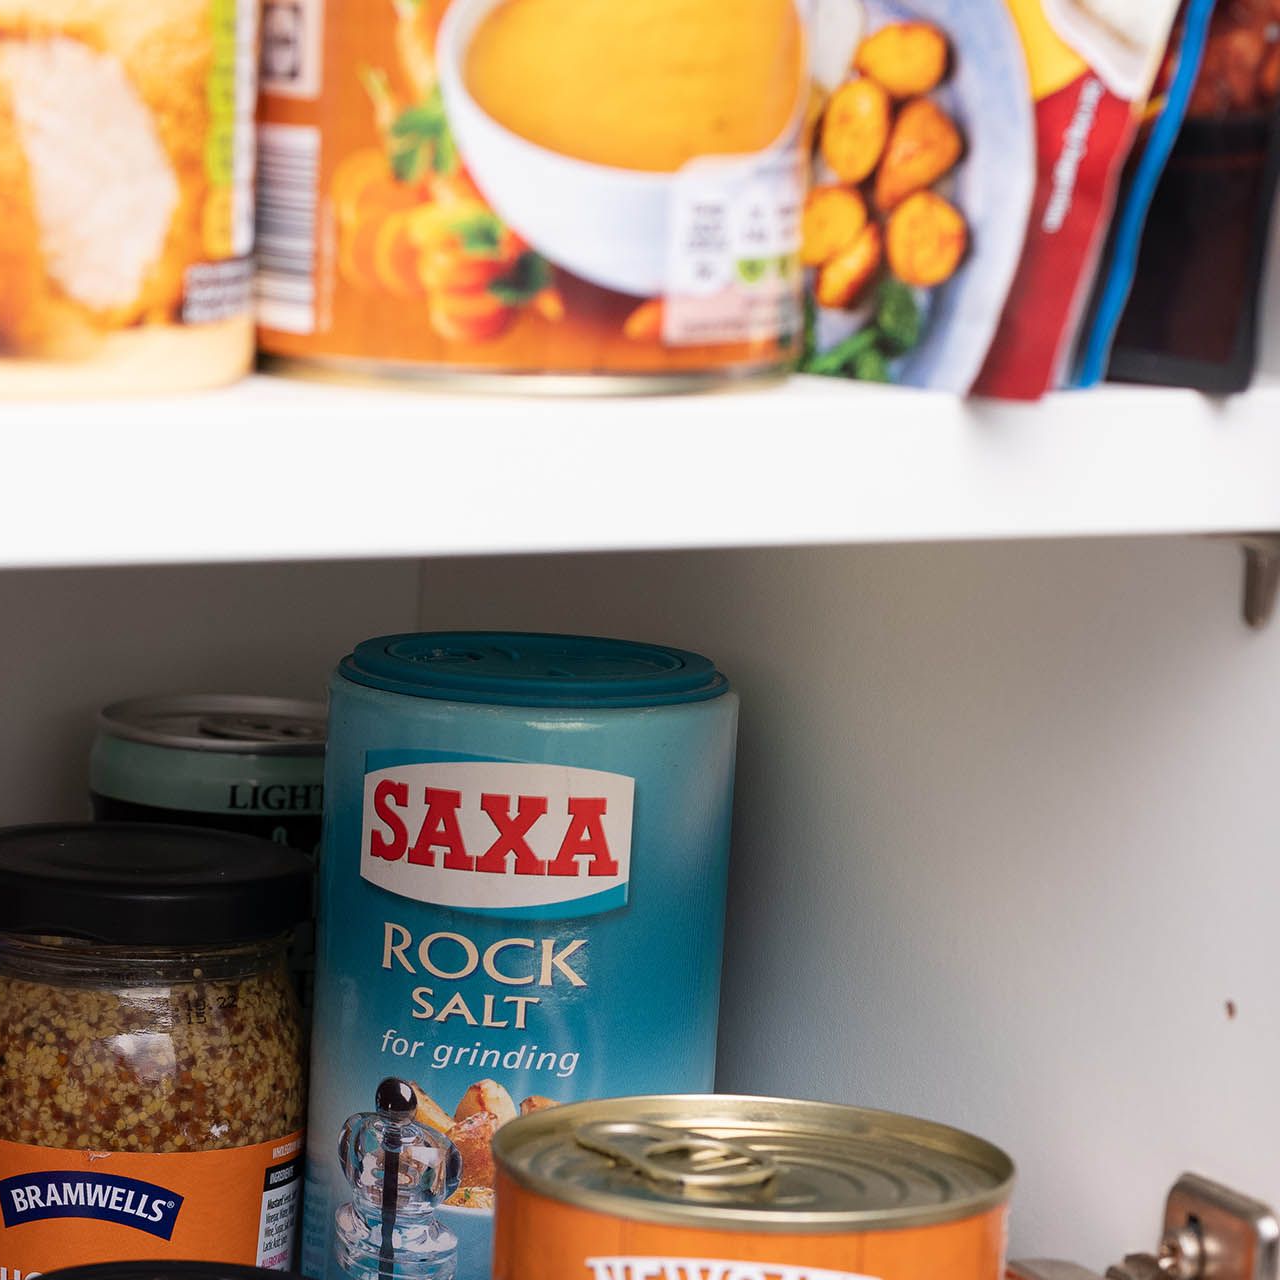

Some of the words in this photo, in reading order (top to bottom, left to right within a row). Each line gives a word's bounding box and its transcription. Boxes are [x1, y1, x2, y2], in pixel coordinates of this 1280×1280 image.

[371, 779, 618, 876] SAXA
[382, 922, 589, 986] ROCK
[412, 987, 540, 1029] SALT
[381, 1030, 423, 1058] for
[431, 1042, 579, 1077] grinding
[10, 1182, 166, 1223] BRAMWELLS
